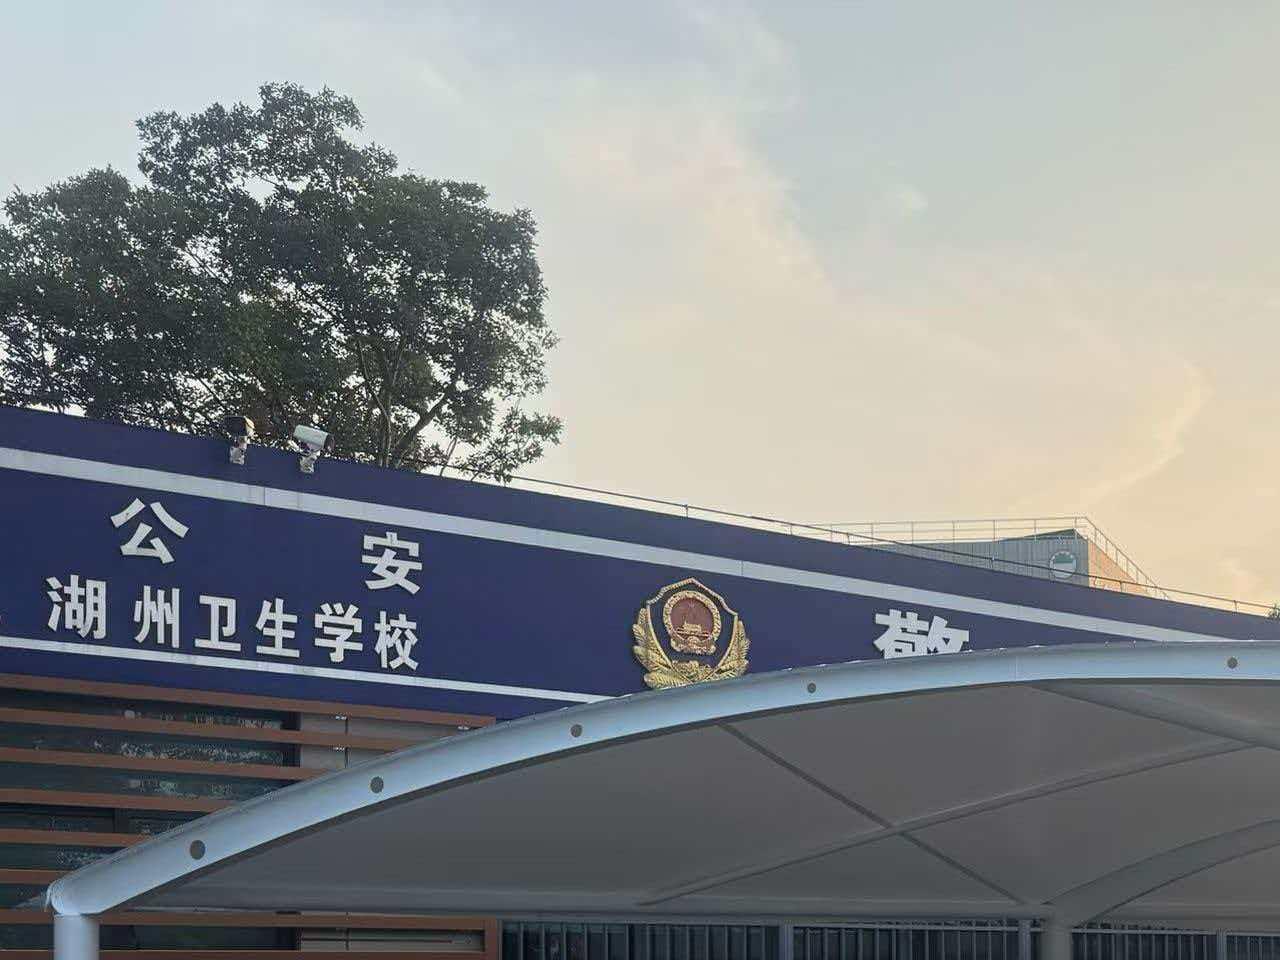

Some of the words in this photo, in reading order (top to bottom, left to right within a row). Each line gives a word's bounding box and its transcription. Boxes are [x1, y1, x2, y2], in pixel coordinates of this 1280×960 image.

[46, 574, 418, 670] 湖州卫生学校
